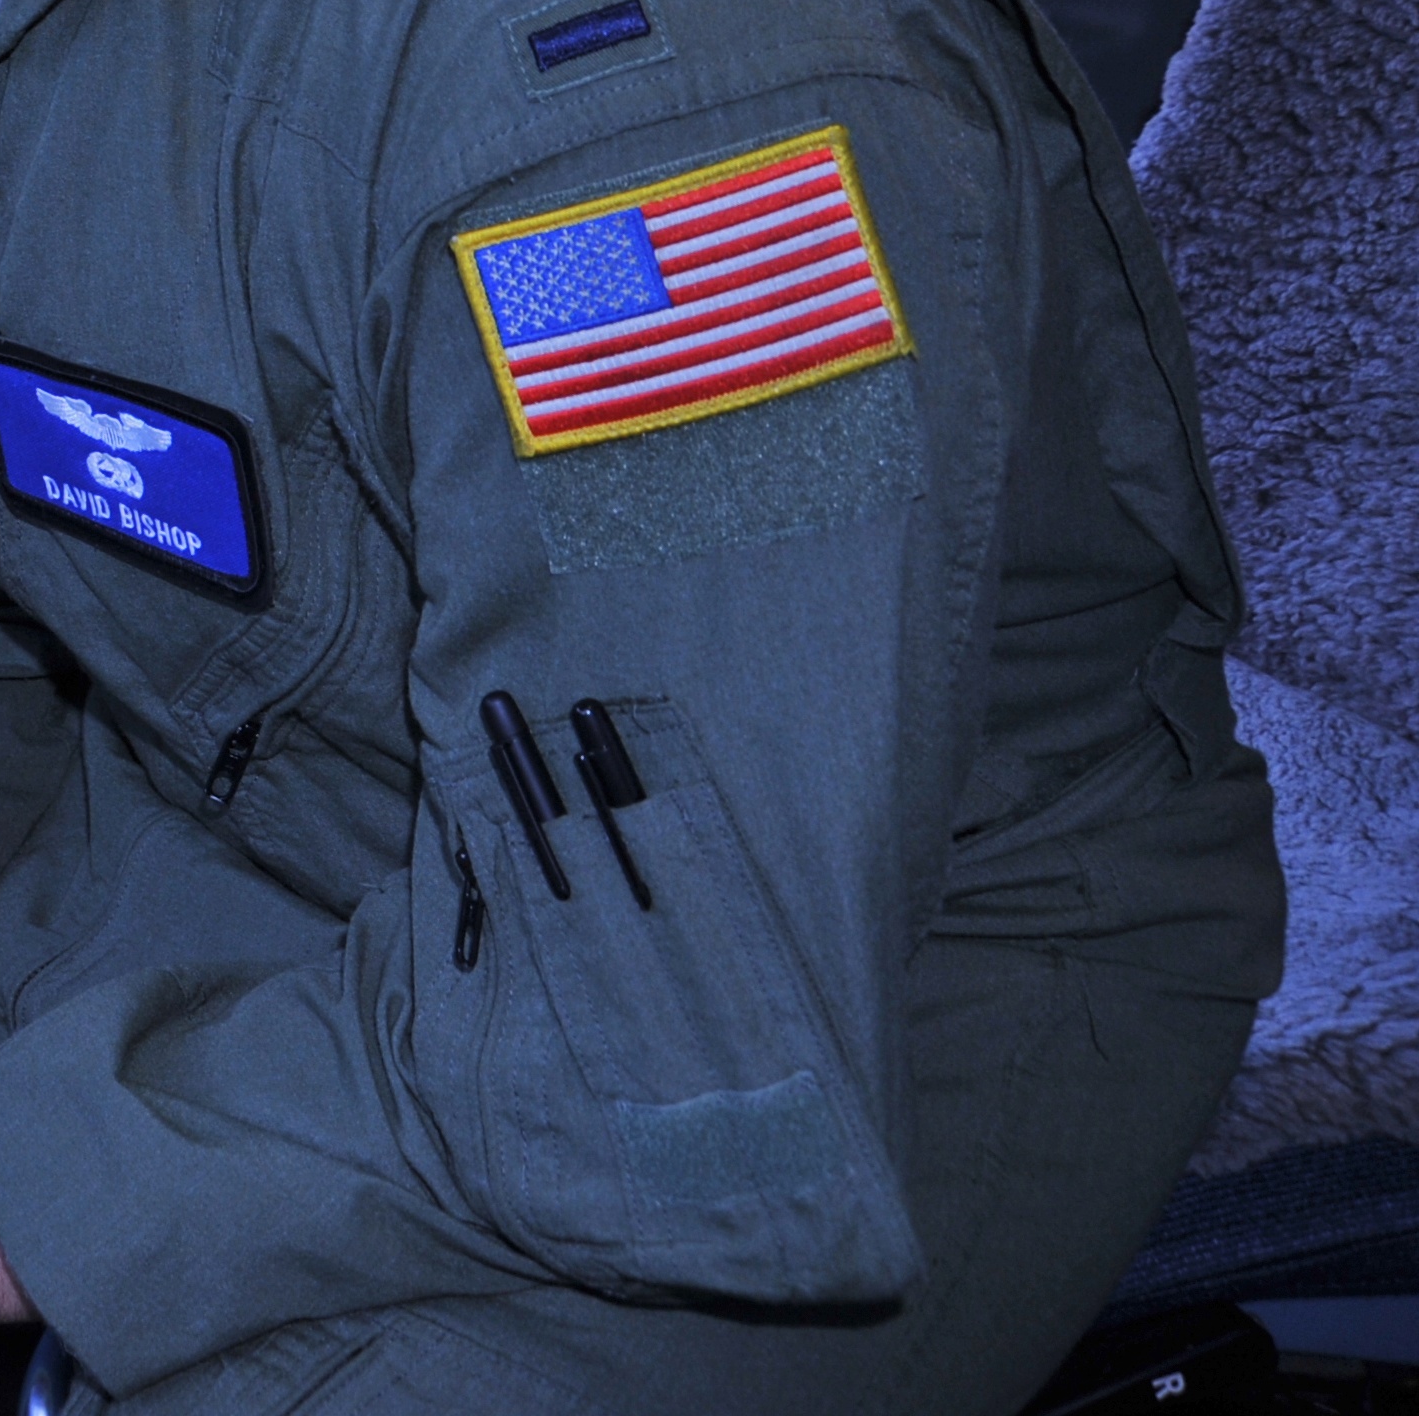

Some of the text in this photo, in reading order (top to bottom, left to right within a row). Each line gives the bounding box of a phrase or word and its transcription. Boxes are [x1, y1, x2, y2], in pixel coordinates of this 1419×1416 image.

[42, 475, 202, 556] DAVID BISHOP
[1152, 1370, 1186, 1401] R
